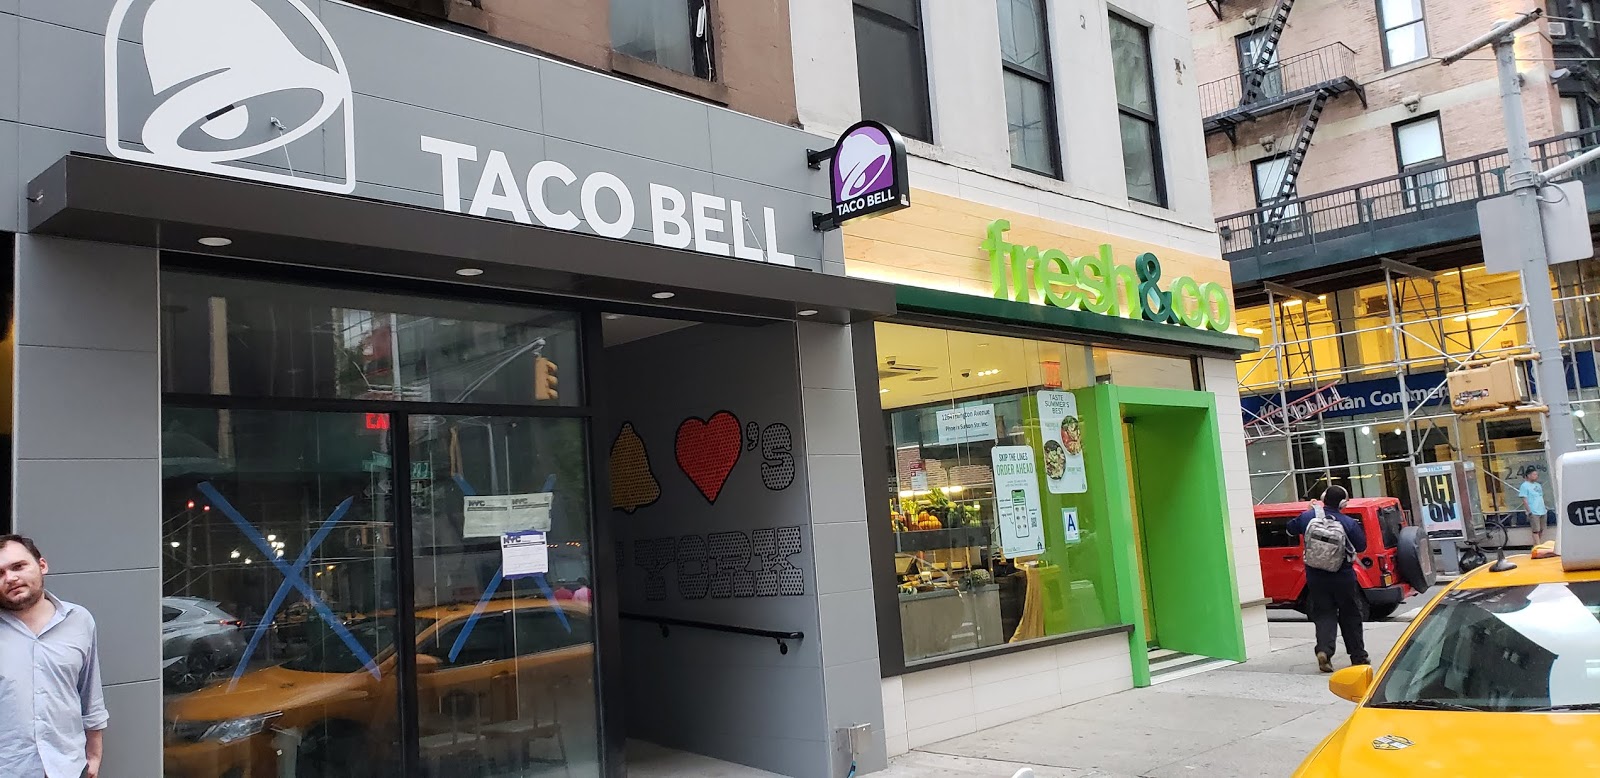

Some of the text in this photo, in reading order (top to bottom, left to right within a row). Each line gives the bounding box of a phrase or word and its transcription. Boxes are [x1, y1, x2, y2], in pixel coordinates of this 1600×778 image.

[420, 135, 795, 267] TACO BELL
[836, 189, 895, 216] TACO BELL
[981, 219, 1231, 333] fresh&co
[974, 409, 990, 417] Avenue
[1259, 386, 1449, 419] Meroplitan Commer
[998, 452, 1028, 461] SKIP THE LINES
[996, 462, 1034, 476] ORDER AHEAD
[511, 497, 528, 505] NYC
[1418, 473, 1456, 507] ACT
[1067, 513, 1077, 532] A
[1429, 501, 1457, 523] ON
[503, 535, 522, 544] NYC
[634, 526, 804, 600] YORK
